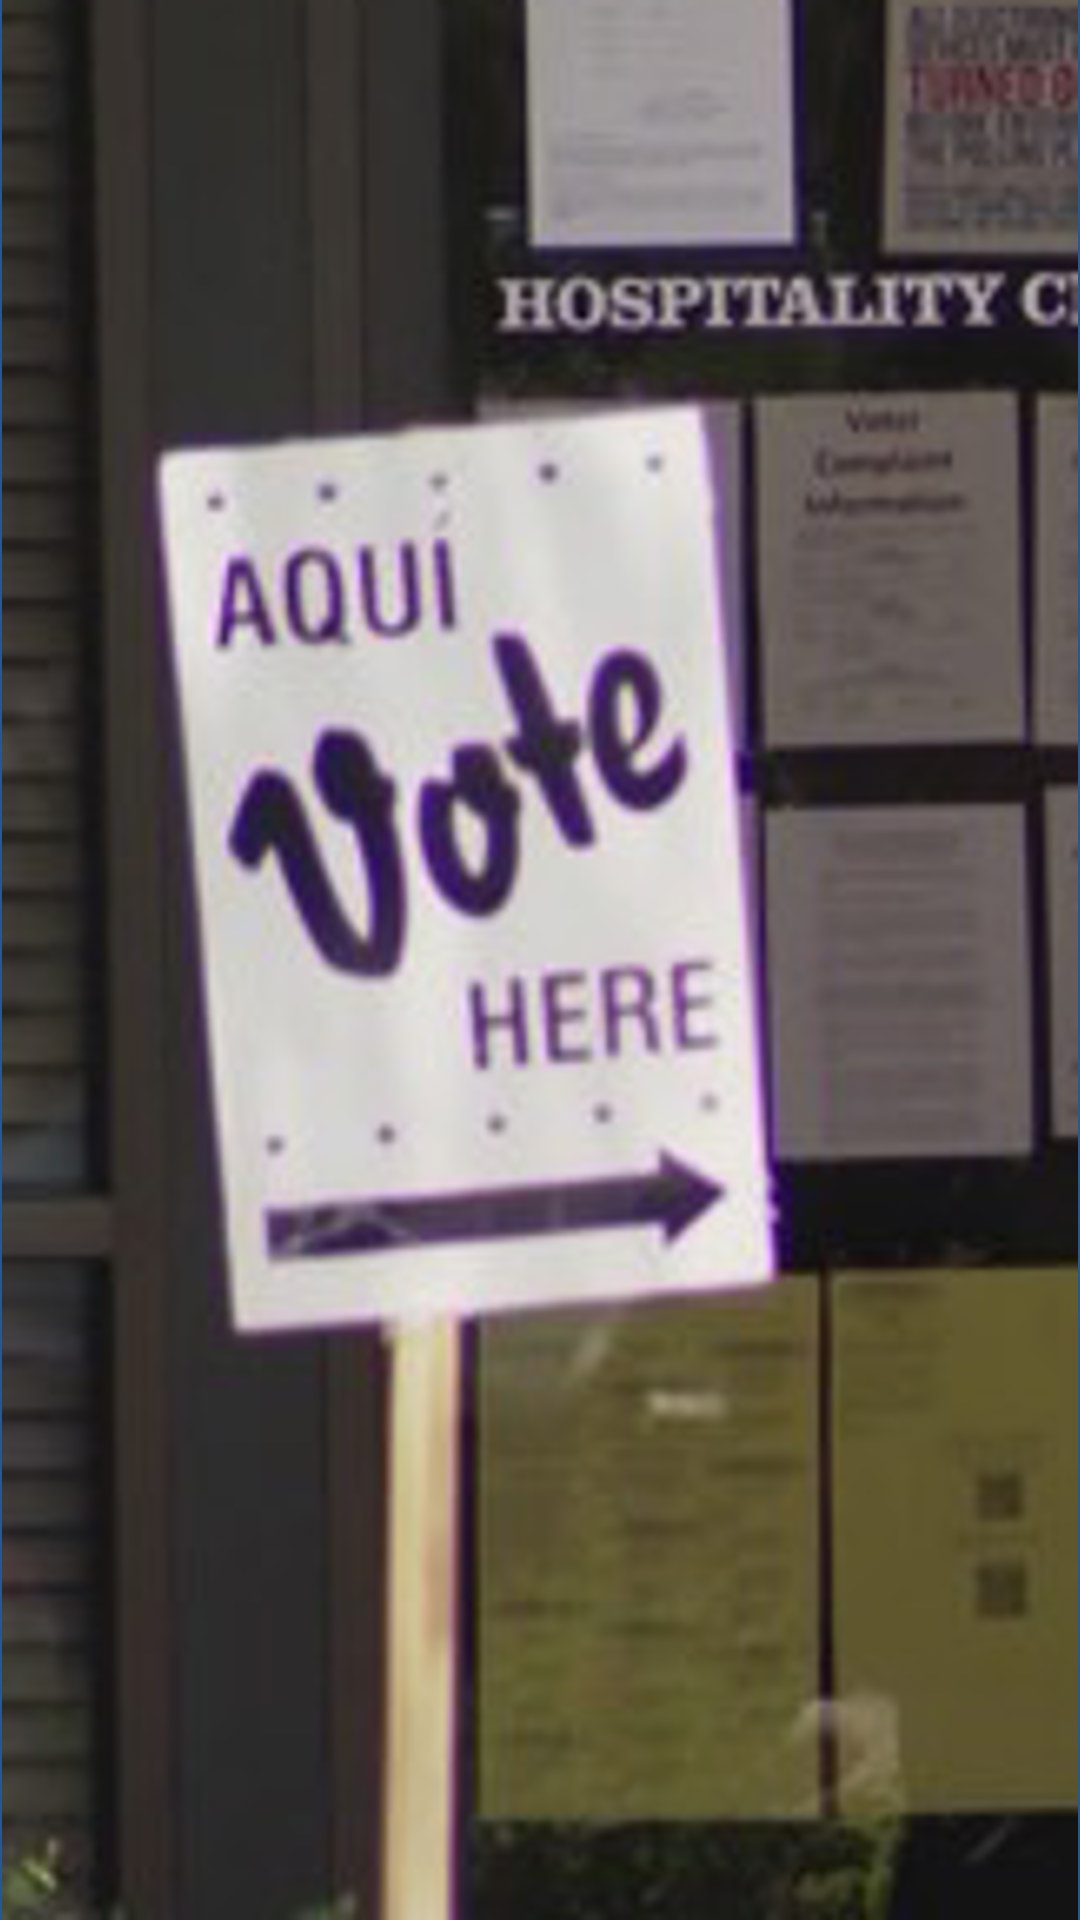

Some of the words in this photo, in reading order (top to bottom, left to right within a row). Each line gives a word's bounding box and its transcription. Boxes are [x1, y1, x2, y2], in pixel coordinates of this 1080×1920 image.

[1050, 62, 1078, 111] O
[497, 272, 1004, 332] HOSPITALITY
[215, 508, 456, 649] AQUÍ
[229, 632, 688, 981] Vote
[469, 958, 720, 1071] HERE
